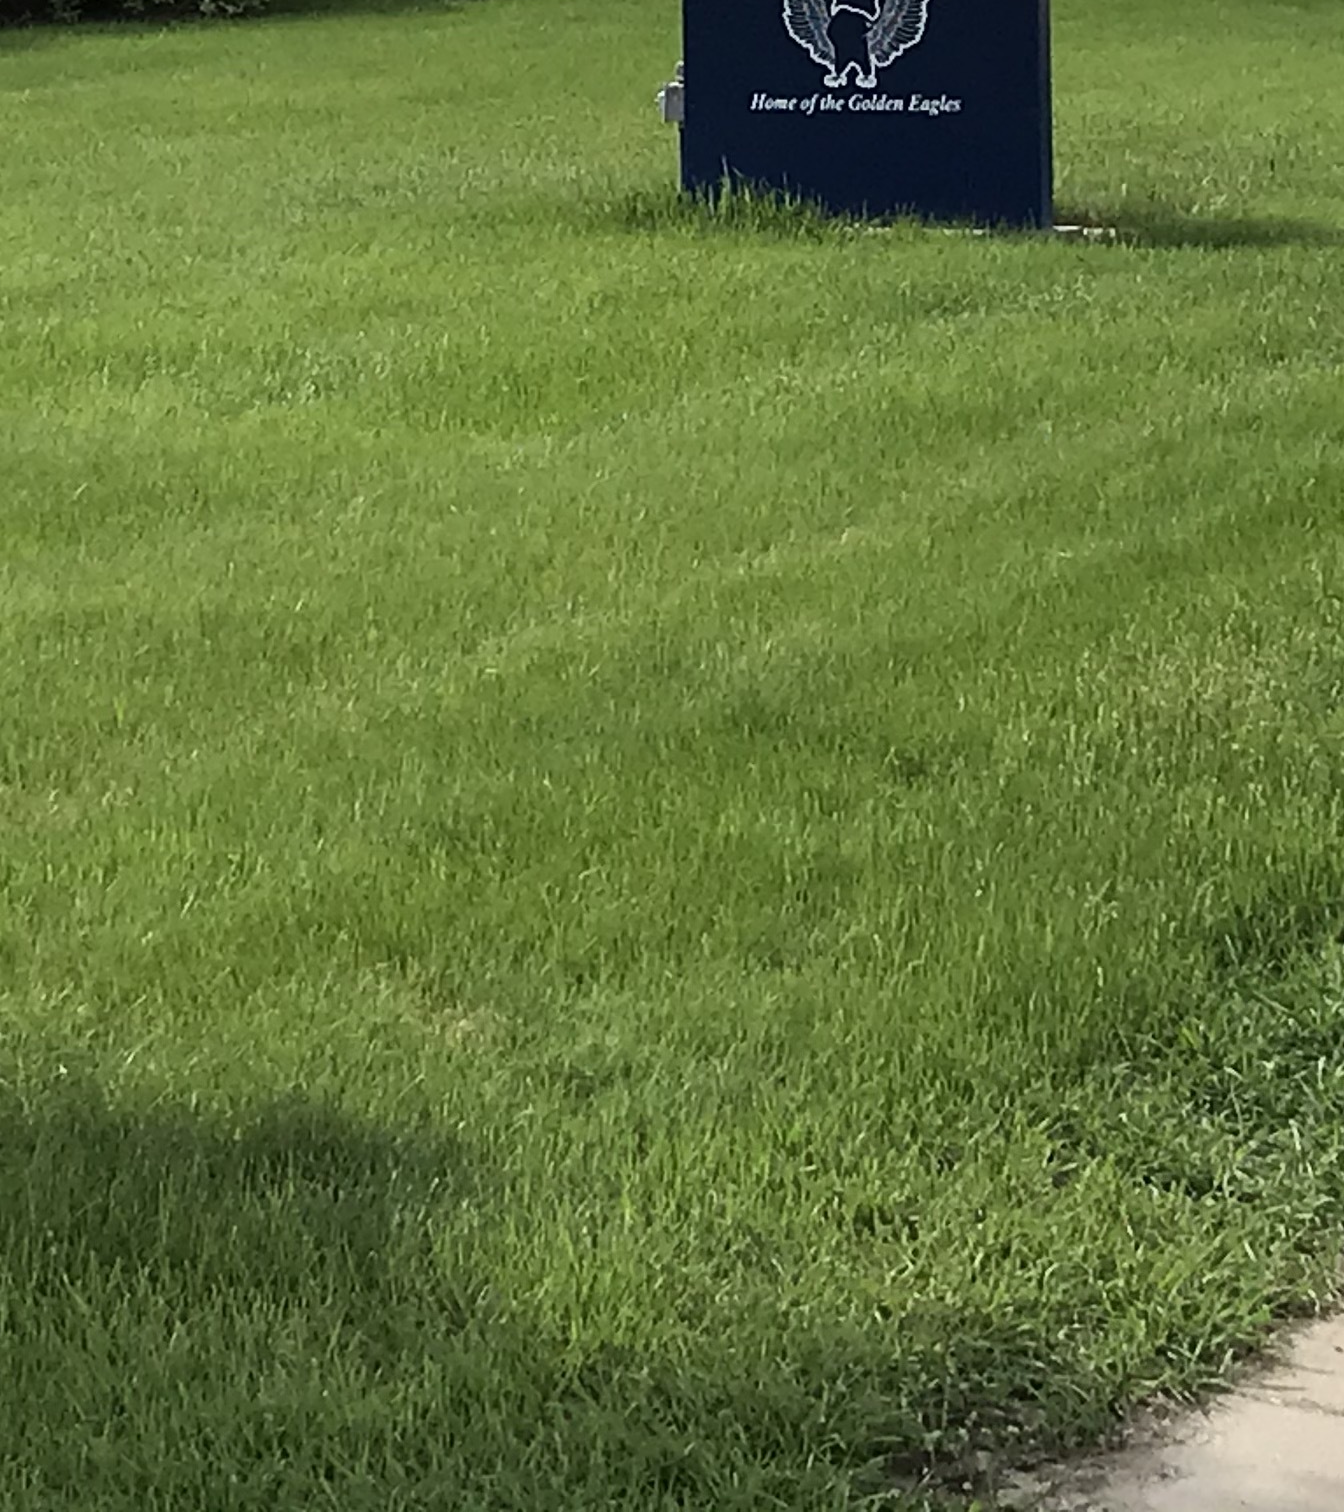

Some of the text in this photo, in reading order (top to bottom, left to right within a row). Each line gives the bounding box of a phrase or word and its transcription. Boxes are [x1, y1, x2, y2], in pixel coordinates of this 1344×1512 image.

[751, 94, 960, 115] Home of the Golden Eagles
